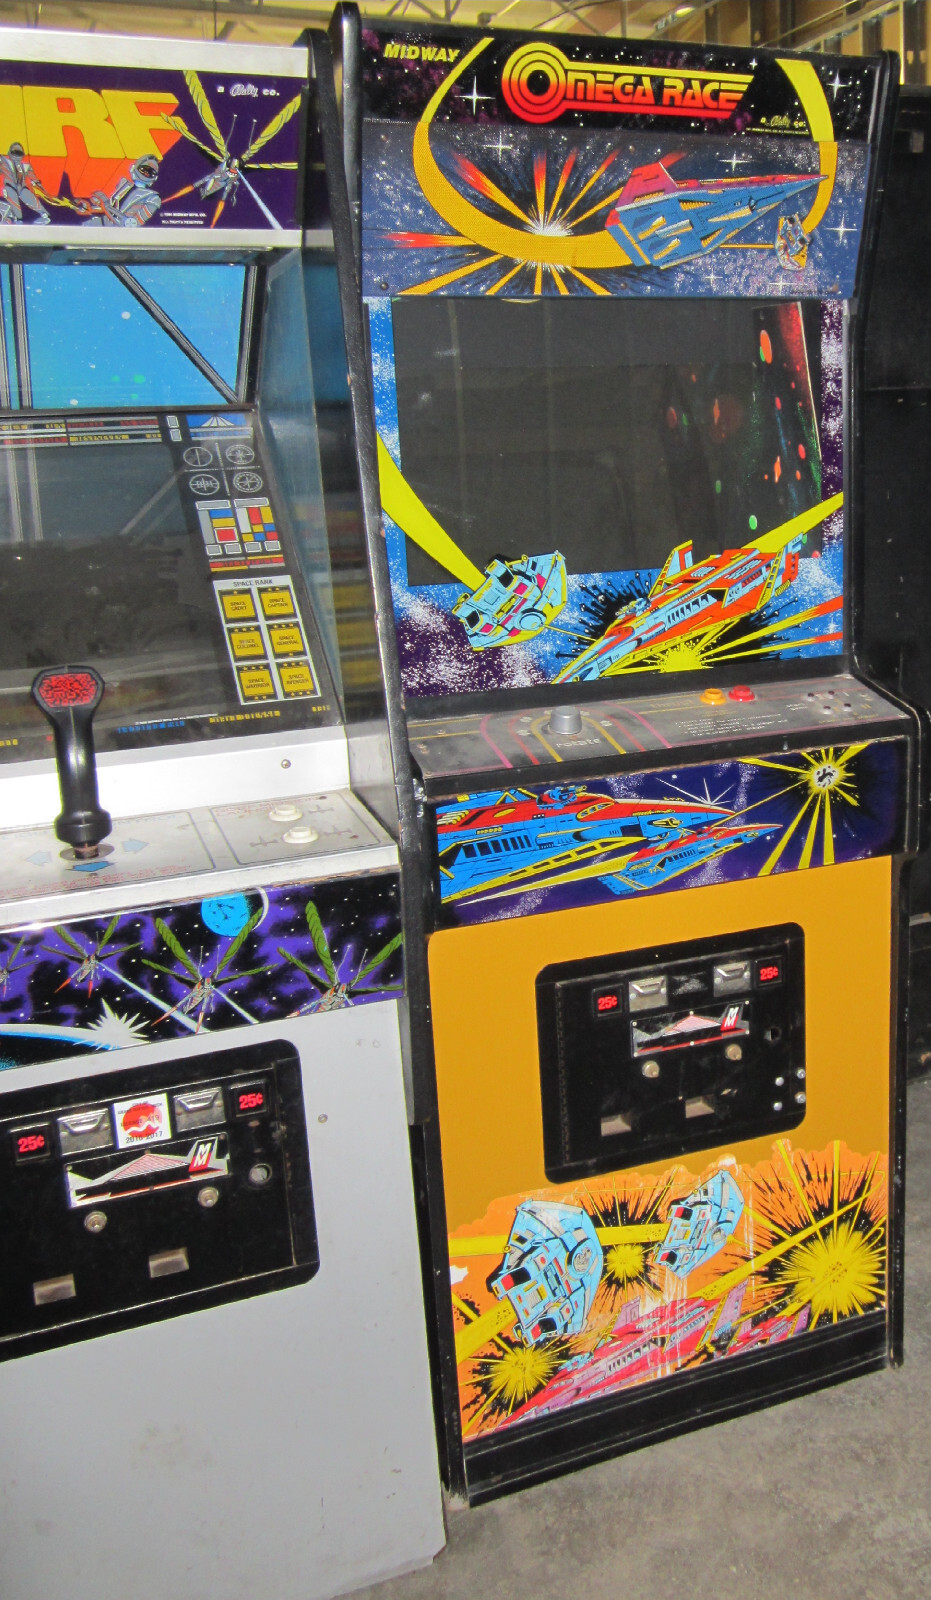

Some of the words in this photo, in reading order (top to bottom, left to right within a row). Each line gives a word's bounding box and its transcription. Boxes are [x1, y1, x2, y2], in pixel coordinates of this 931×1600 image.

[383, 43, 460, 62] MIDWAY
[501, 42, 655, 123] OMEGA
[662, 77, 749, 110] RACE
[239, 1092, 263, 1110] 25¢
[18, 1135, 45, 1153] 25¢
